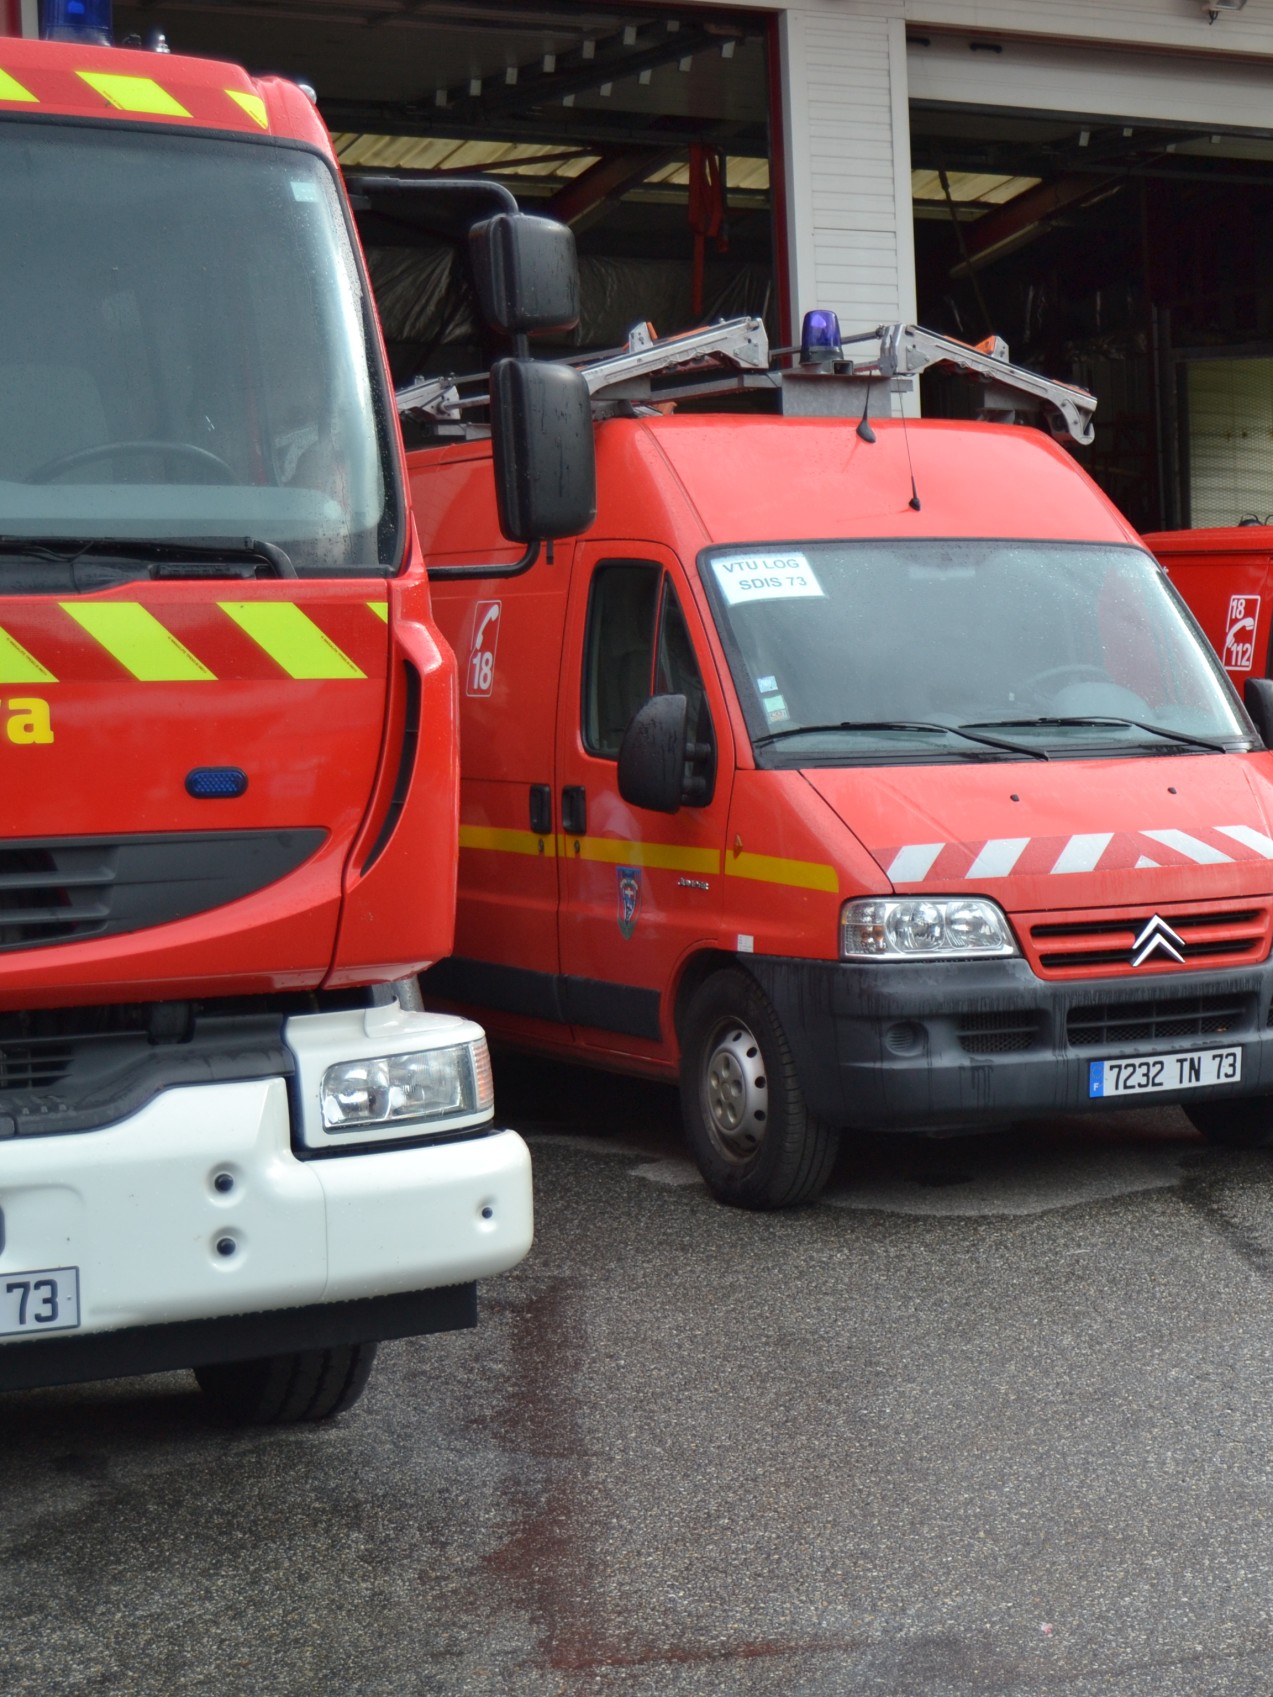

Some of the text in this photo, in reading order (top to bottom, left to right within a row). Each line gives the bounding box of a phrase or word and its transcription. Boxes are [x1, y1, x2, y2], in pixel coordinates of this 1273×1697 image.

[722, 558, 800, 573] VTU LOG
[739, 576, 807, 591] SDIS 73
[1231, 599, 1246, 619] 18
[1231, 643, 1252, 666] 112
[472, 651, 493, 690] 18
[0, 697, 55, 745] a
[1109, 1052, 1237, 1091] 7232 TN 73
[1093, 1082, 1100, 1091] F
[6, 1278, 59, 1326] 73
